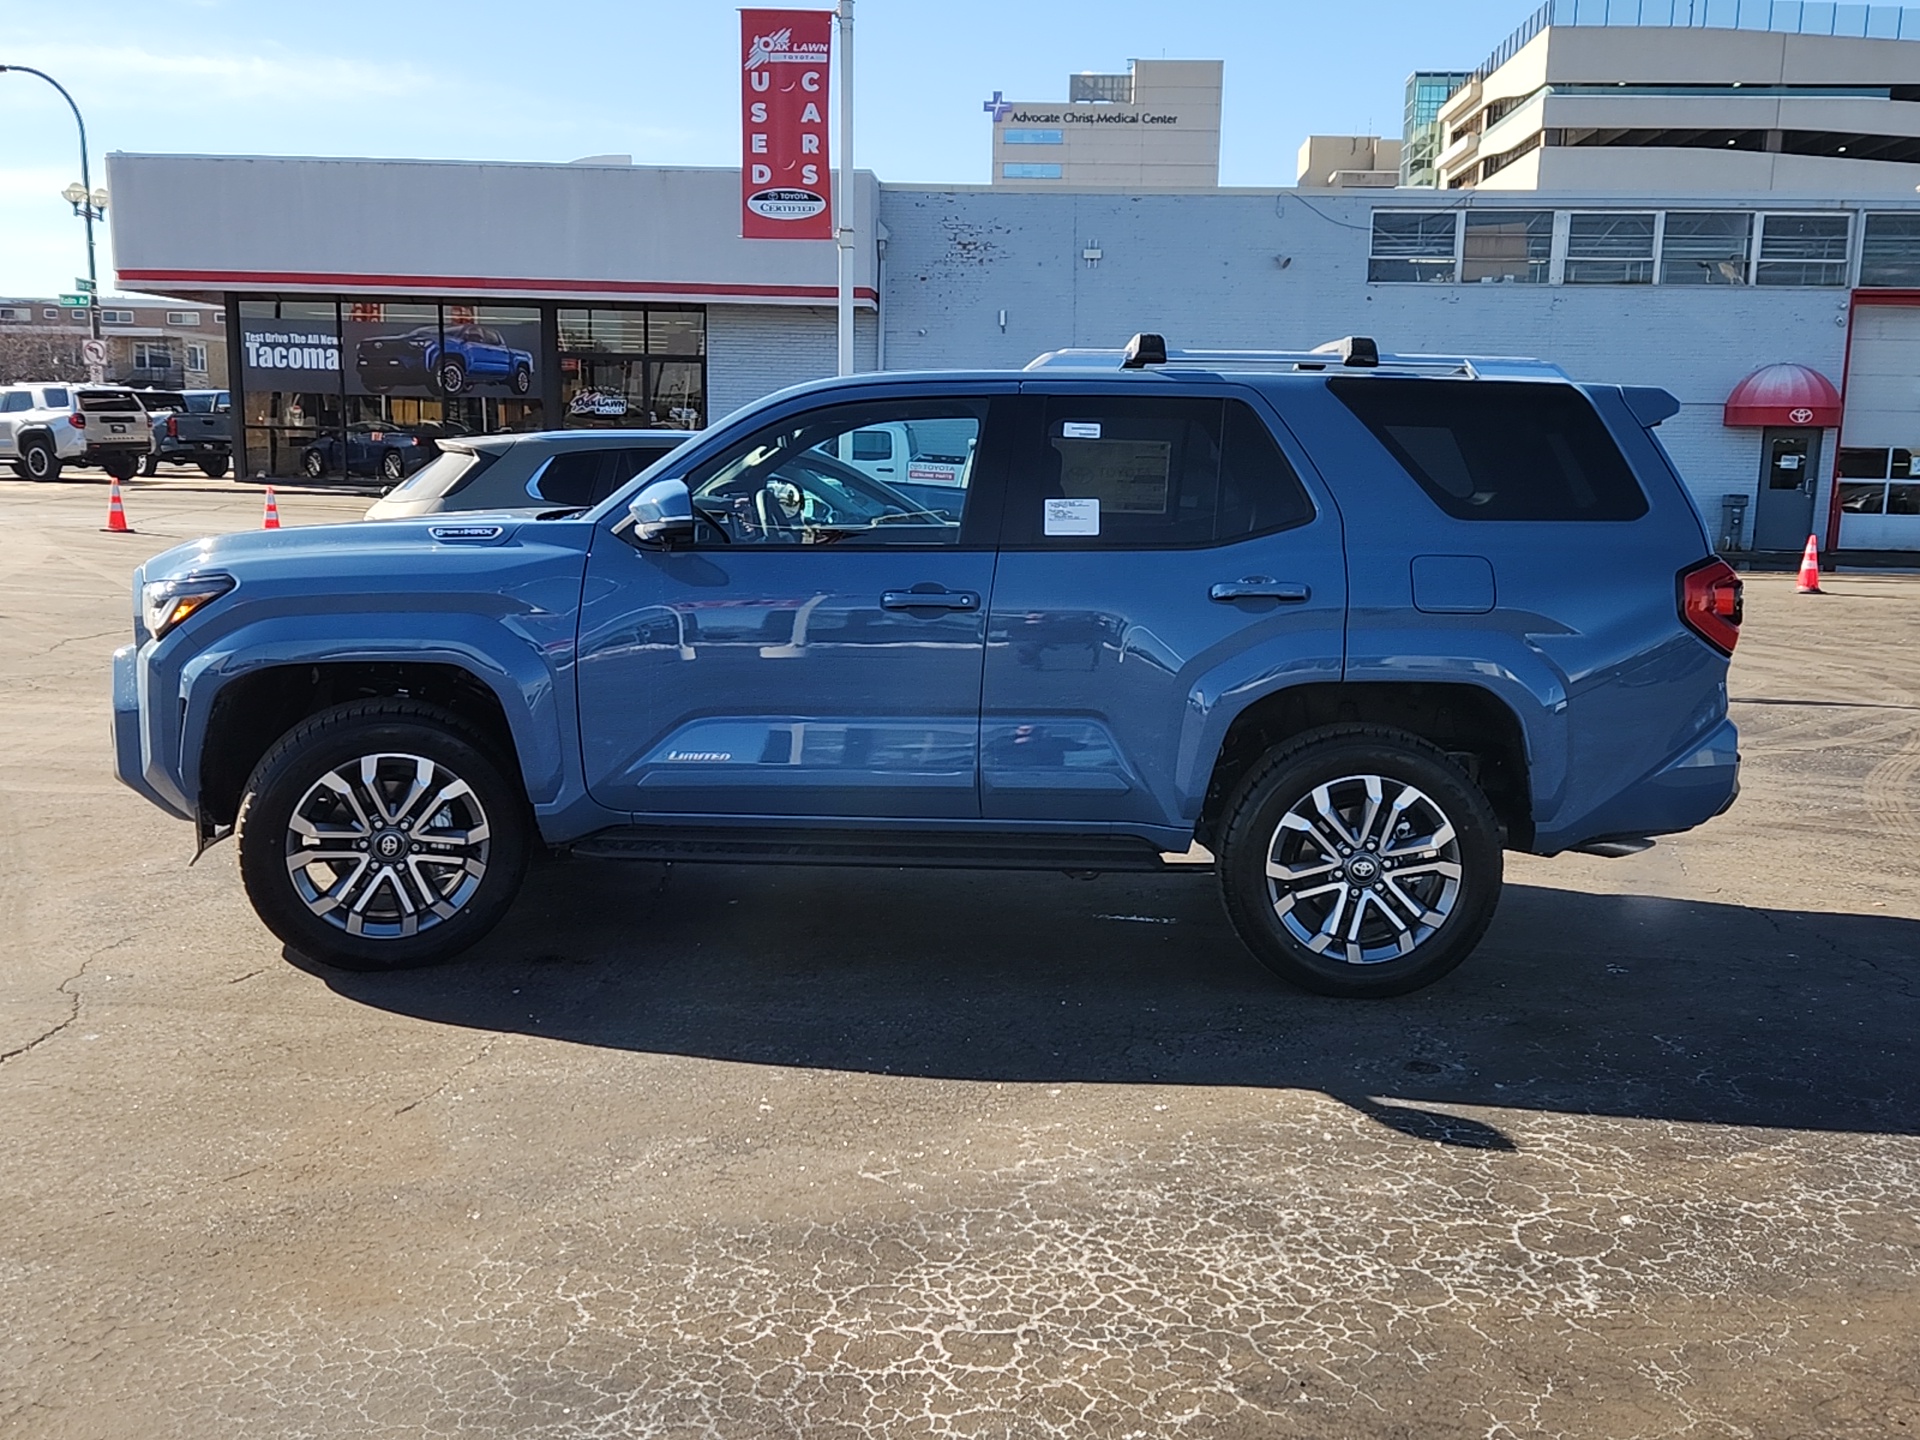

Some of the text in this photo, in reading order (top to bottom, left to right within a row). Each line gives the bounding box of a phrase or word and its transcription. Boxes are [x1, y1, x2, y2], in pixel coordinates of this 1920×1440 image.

[793, 43, 828, 52] LAWN
[1011, 112, 1178, 124] Advocate Christ Medical Center
[751, 71, 772, 184] USED
[801, 71, 821, 185] CARS
[780, 192, 809, 200] TOYOTA
[760, 203, 816, 212] CERTIFIED
[244, 332, 264, 342] Test
[265, 333, 288, 343] Drive
[289, 333, 306, 344] The
[307, 334, 319, 344] All
[245, 342, 340, 370] Tacoma
[923, 464, 955, 472] TOYOTA
